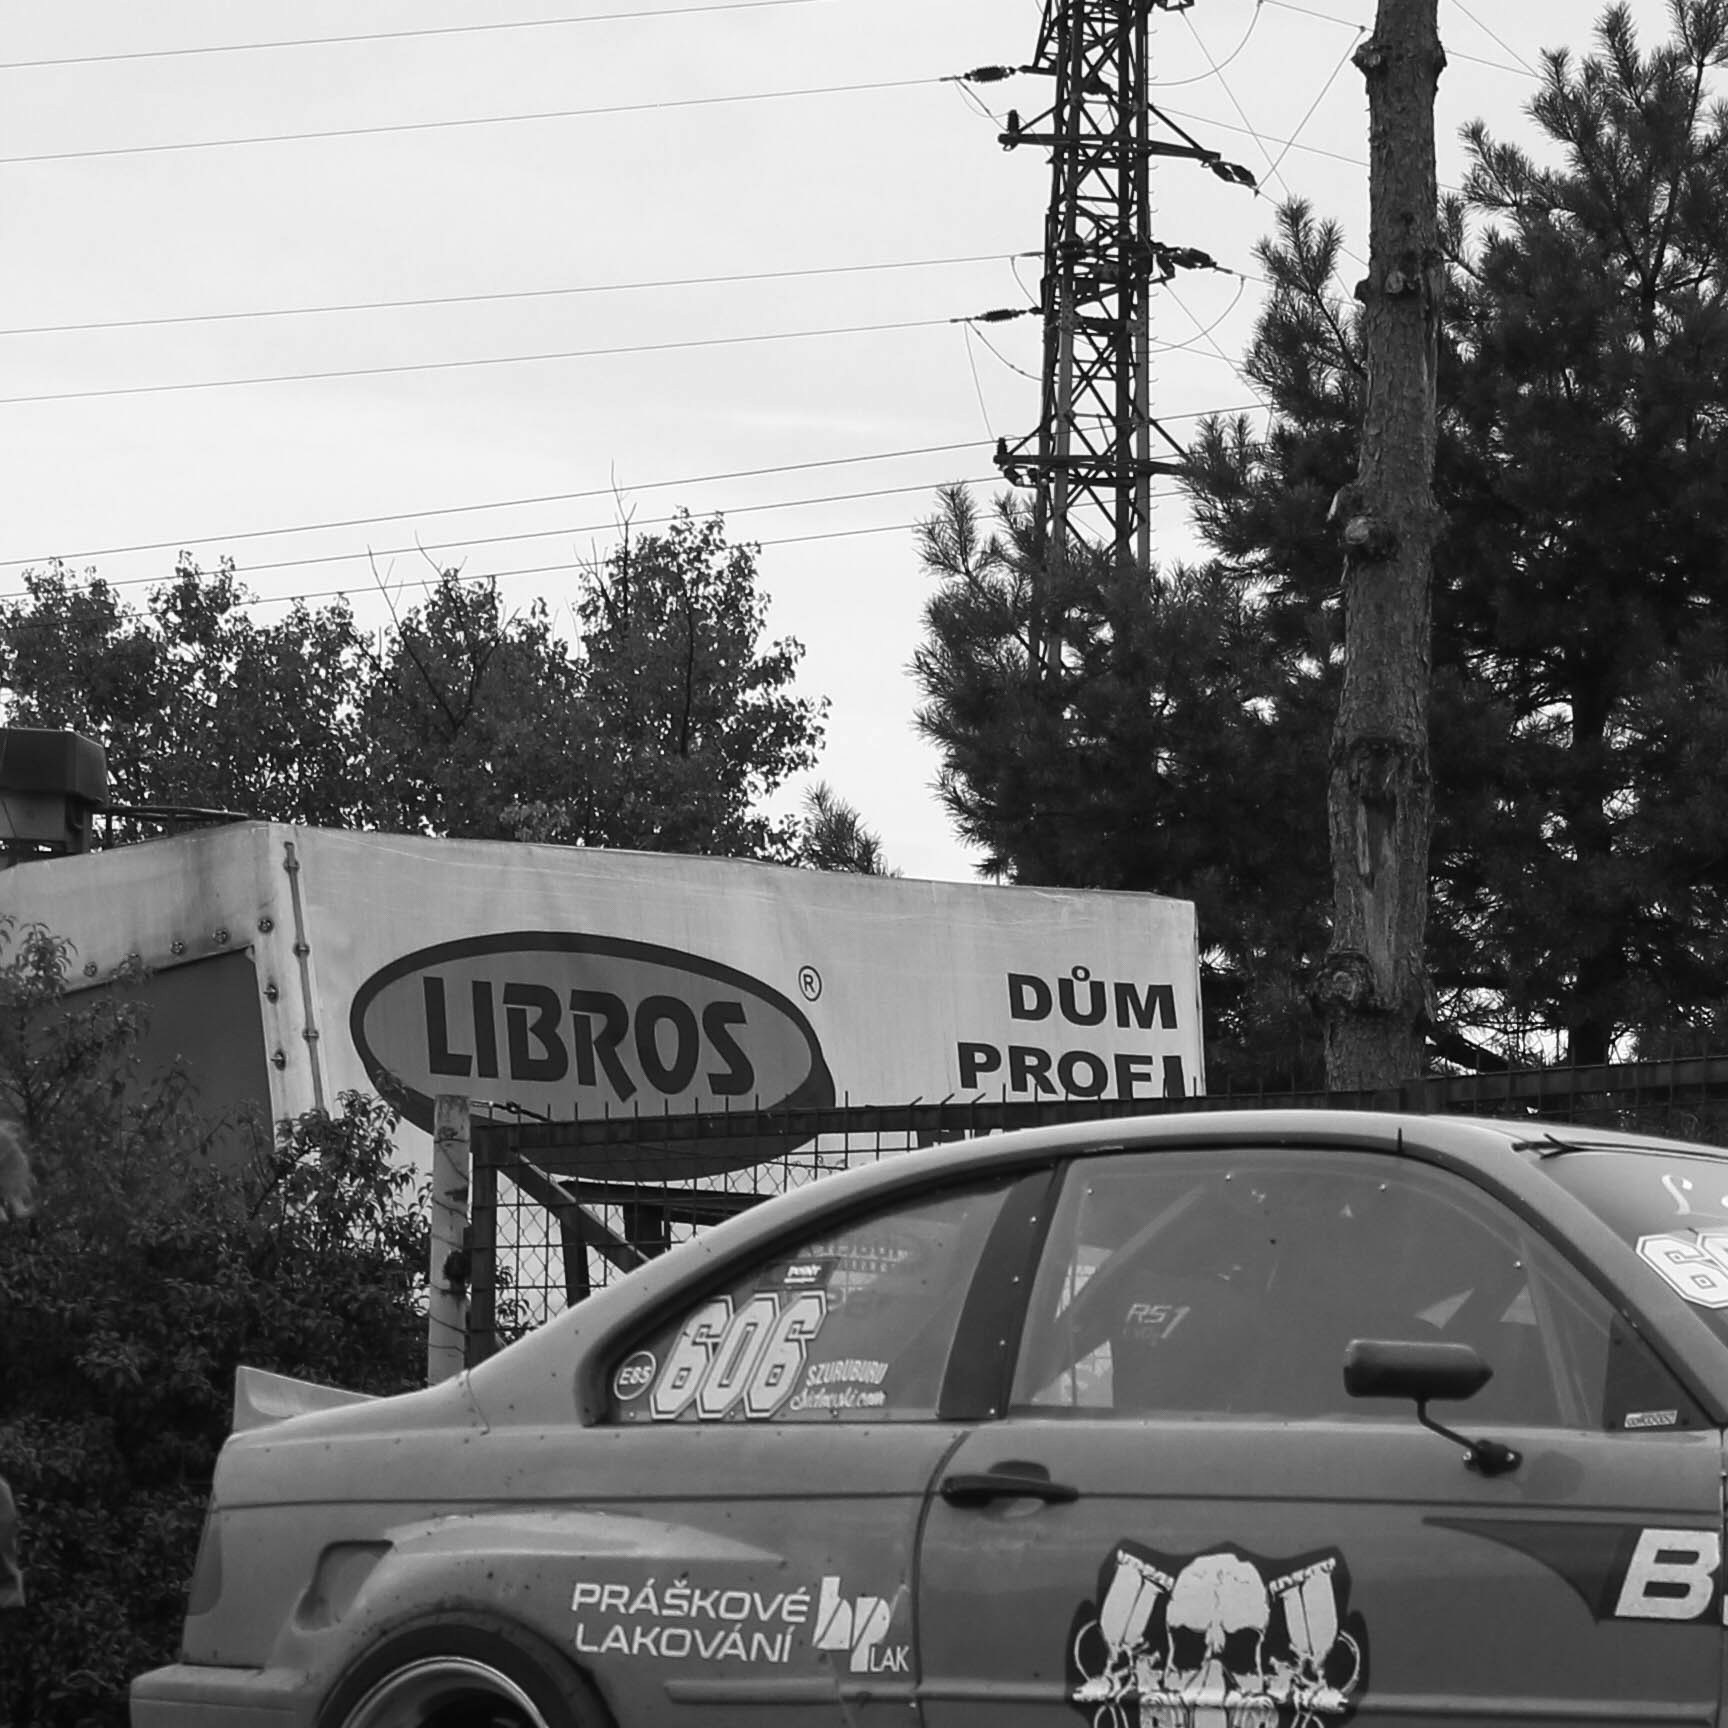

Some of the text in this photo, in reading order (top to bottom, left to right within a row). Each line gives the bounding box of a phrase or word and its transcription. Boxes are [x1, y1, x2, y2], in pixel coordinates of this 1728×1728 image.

[1007, 965, 1178, 1030] DŮM
[423, 976, 754, 1102] LIBROS
[957, 1042, 1186, 1099] PROFI
[618, 1365, 652, 1386] E85
[651, 1289, 828, 1419] 606
[571, 1578, 811, 1624] PRÁŠKOVÉ
[575, 1622, 796, 1664] LAKOVÁNÍ
[869, 1644, 910, 1672] LAK
